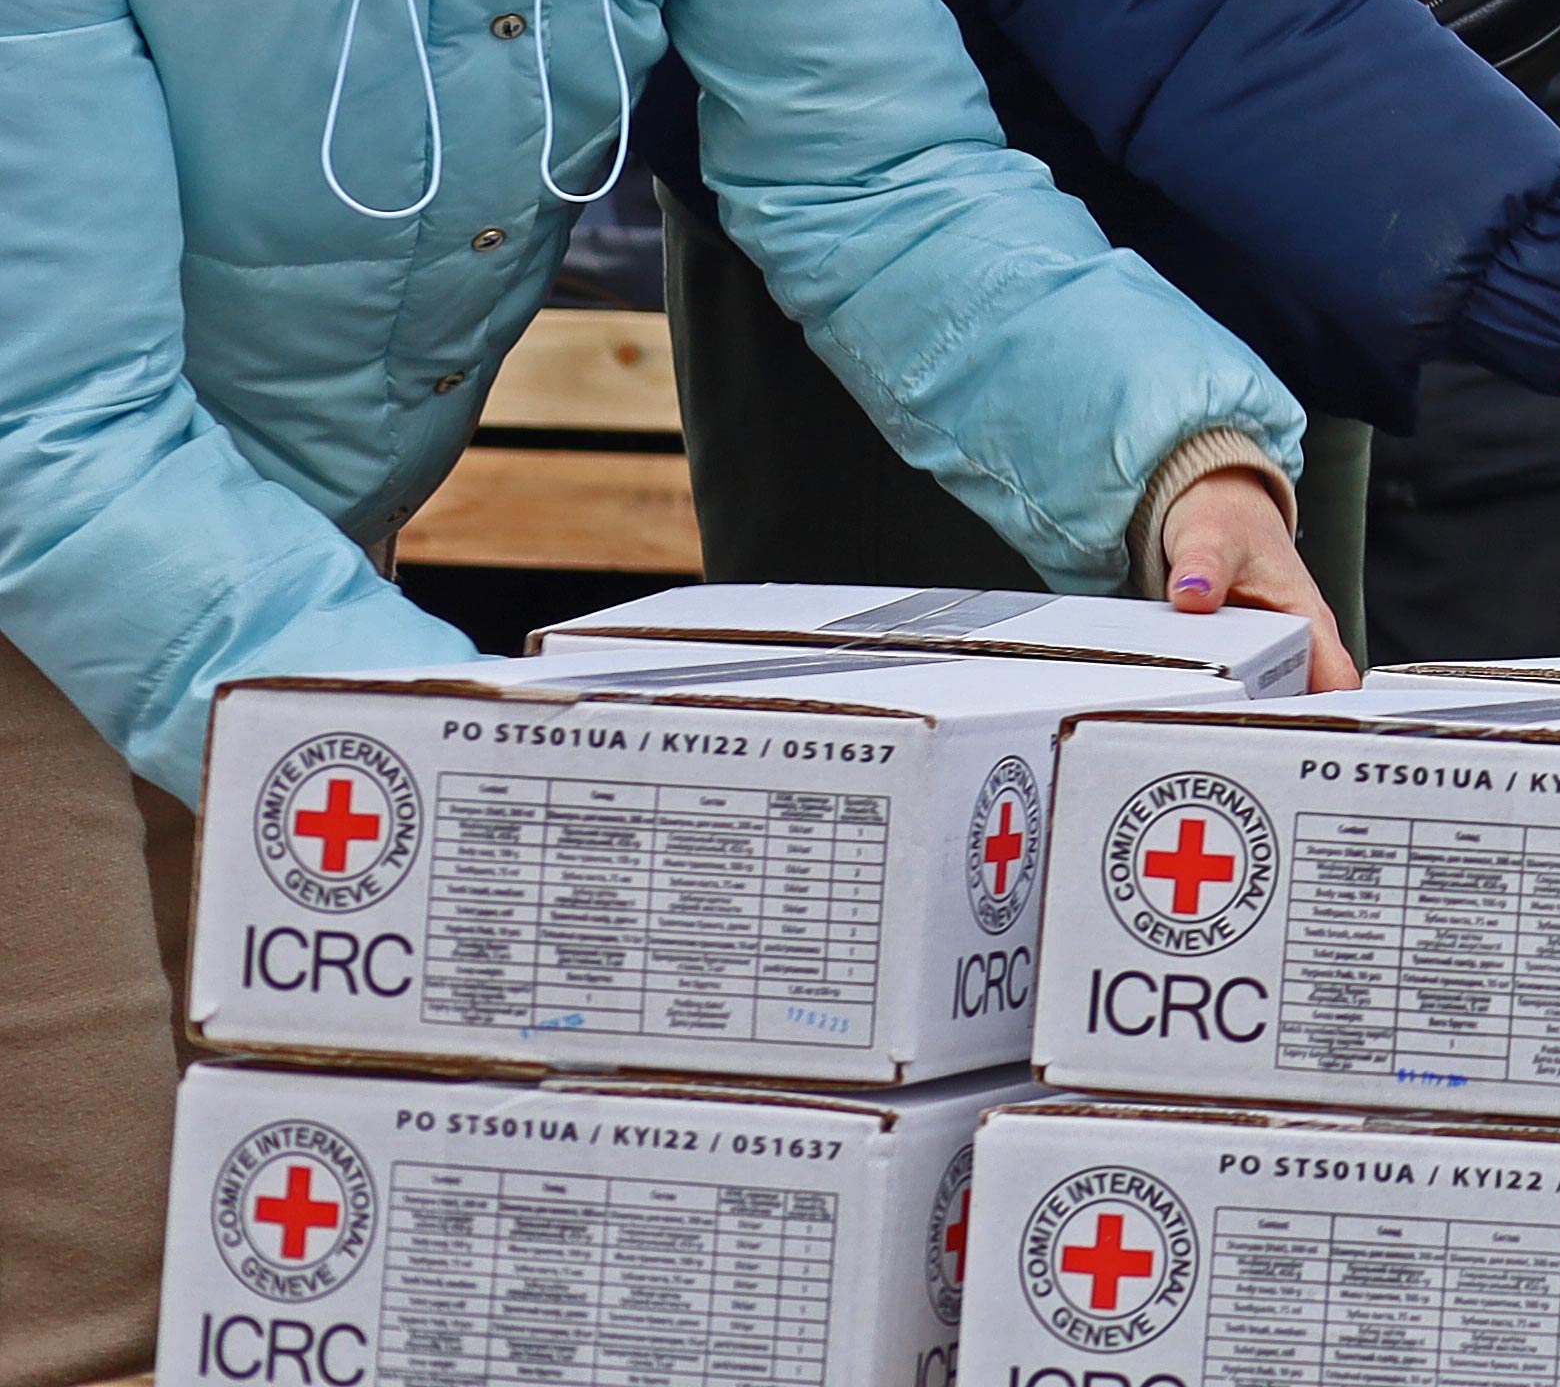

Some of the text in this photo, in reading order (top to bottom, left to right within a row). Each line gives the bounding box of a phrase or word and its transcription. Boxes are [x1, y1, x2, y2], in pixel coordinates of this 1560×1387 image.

[443, 720, 895, 764] PO STS01UA / KYI22 / 051637
[261, 739, 417, 870] COMITE INTERNATIONAL
[1300, 759, 1341, 781] PO
[1354, 762, 1493, 791] STS01UA
[1505, 772, 1518, 792] /
[1110, 778, 1272, 910] COMITE INTERNATIONAL
[285, 869, 383, 907] GENEVE
[242, 925, 415, 997] ICRC
[1134, 910, 1235, 951] GENEVE
[952, 945, 1031, 1020] ICRC
[1087, 968, 1269, 1043] ICRC
[396, 1109, 842, 1161] PO STS01UA / KYI22 / 051637
[219, 1127, 371, 1258] COMITE INTERNATIONAL
[1219, 1153, 1261, 1176] PO
[1274, 1156, 1415, 1185] STS01UA
[1427, 1166, 1439, 1186] /
[1452, 1167, 1542, 1192] KYI22
[1027, 1194, 1070, 1298] COMITE
[1069, 1173, 1192, 1306] INTERNATIONAL
[242, 1256, 337, 1297] GENEVE
[200, 1313, 368, 1387] ICRC
[1052, 1306, 1154, 1347] GENEVE
